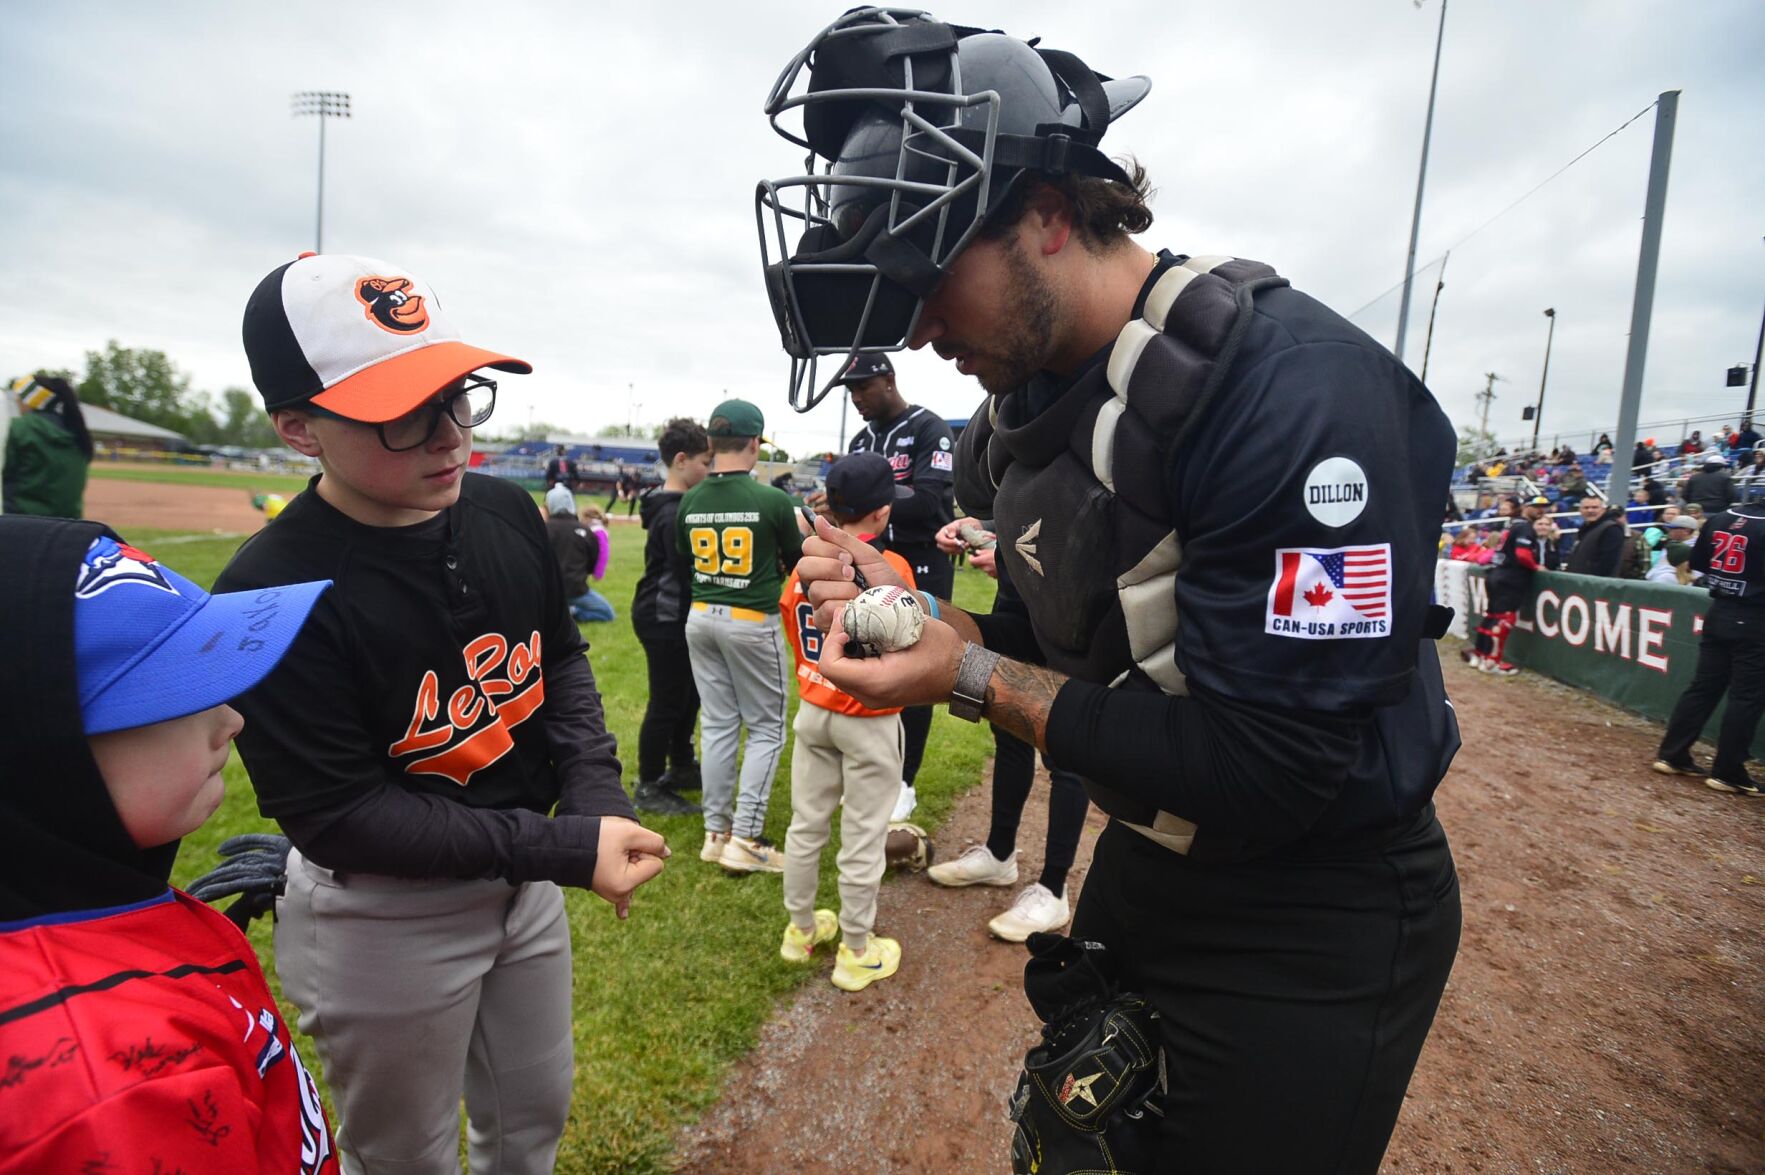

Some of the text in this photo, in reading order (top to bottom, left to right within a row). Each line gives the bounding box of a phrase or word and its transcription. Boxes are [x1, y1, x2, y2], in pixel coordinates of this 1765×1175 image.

[1309, 483, 1364, 504] DILLON
[690, 527, 753, 577] 99
[1710, 530, 1748, 574] 26
[1273, 618, 1386, 636] CAN-USA SPORTS
